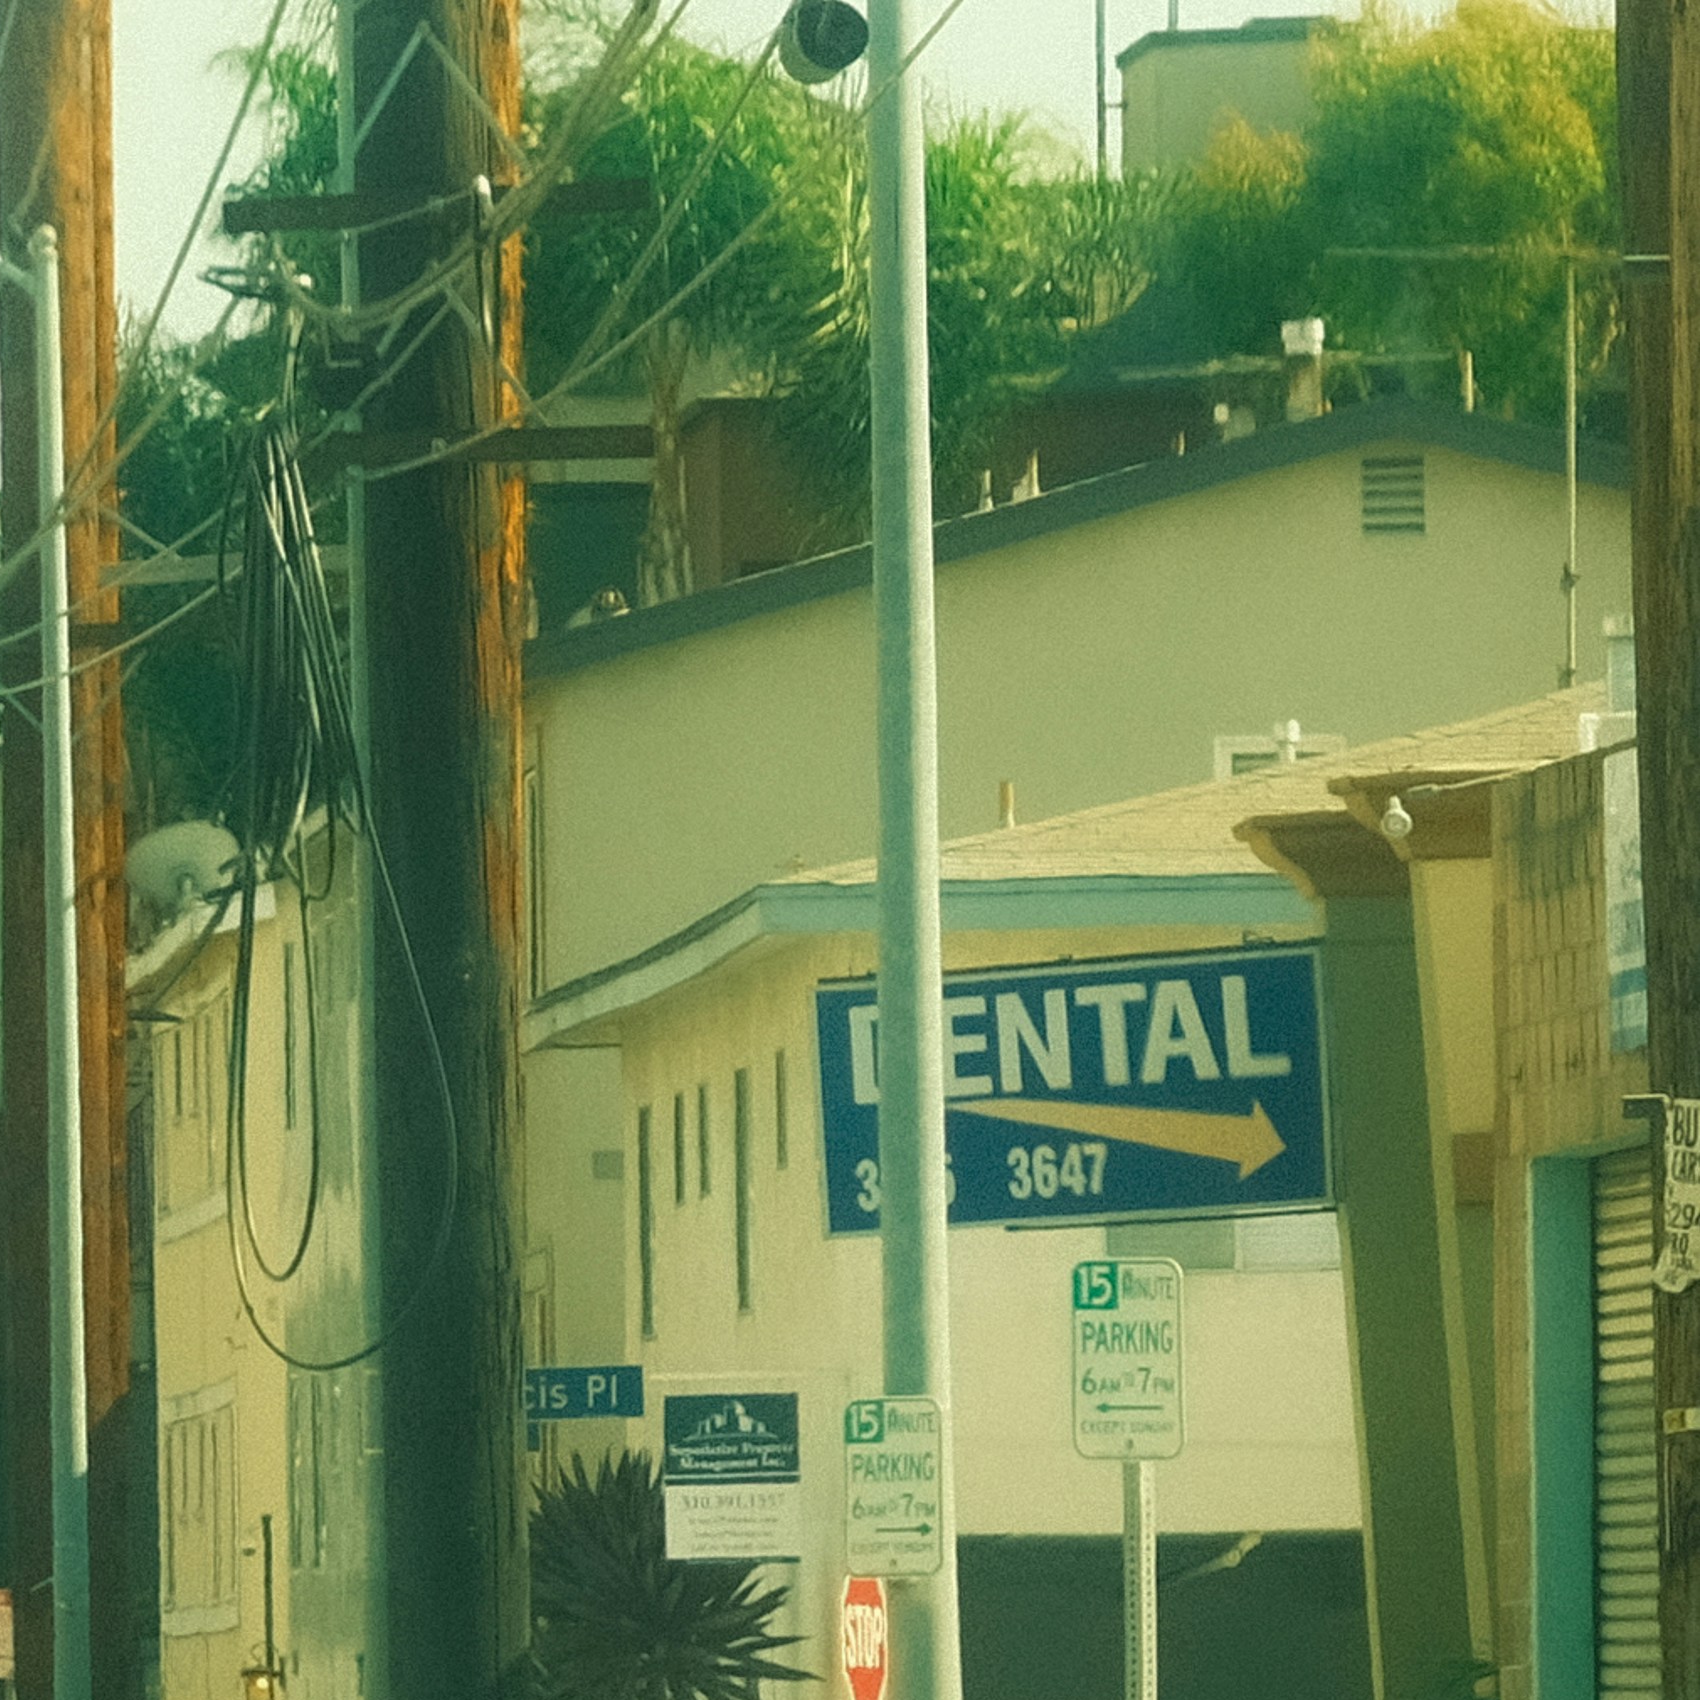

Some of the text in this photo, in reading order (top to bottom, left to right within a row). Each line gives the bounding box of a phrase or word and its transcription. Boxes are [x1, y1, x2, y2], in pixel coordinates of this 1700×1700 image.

[1006, 1142, 1108, 1200] 3647
[1078, 1264, 1113, 1306] 15
[1081, 1320, 1174, 1354] PARKING
[586, 1374, 618, 1409] Pl
[849, 1403, 880, 1440] 15
[852, 1451, 935, 1483] PARKING
[846, 1603, 883, 1670] STOP
